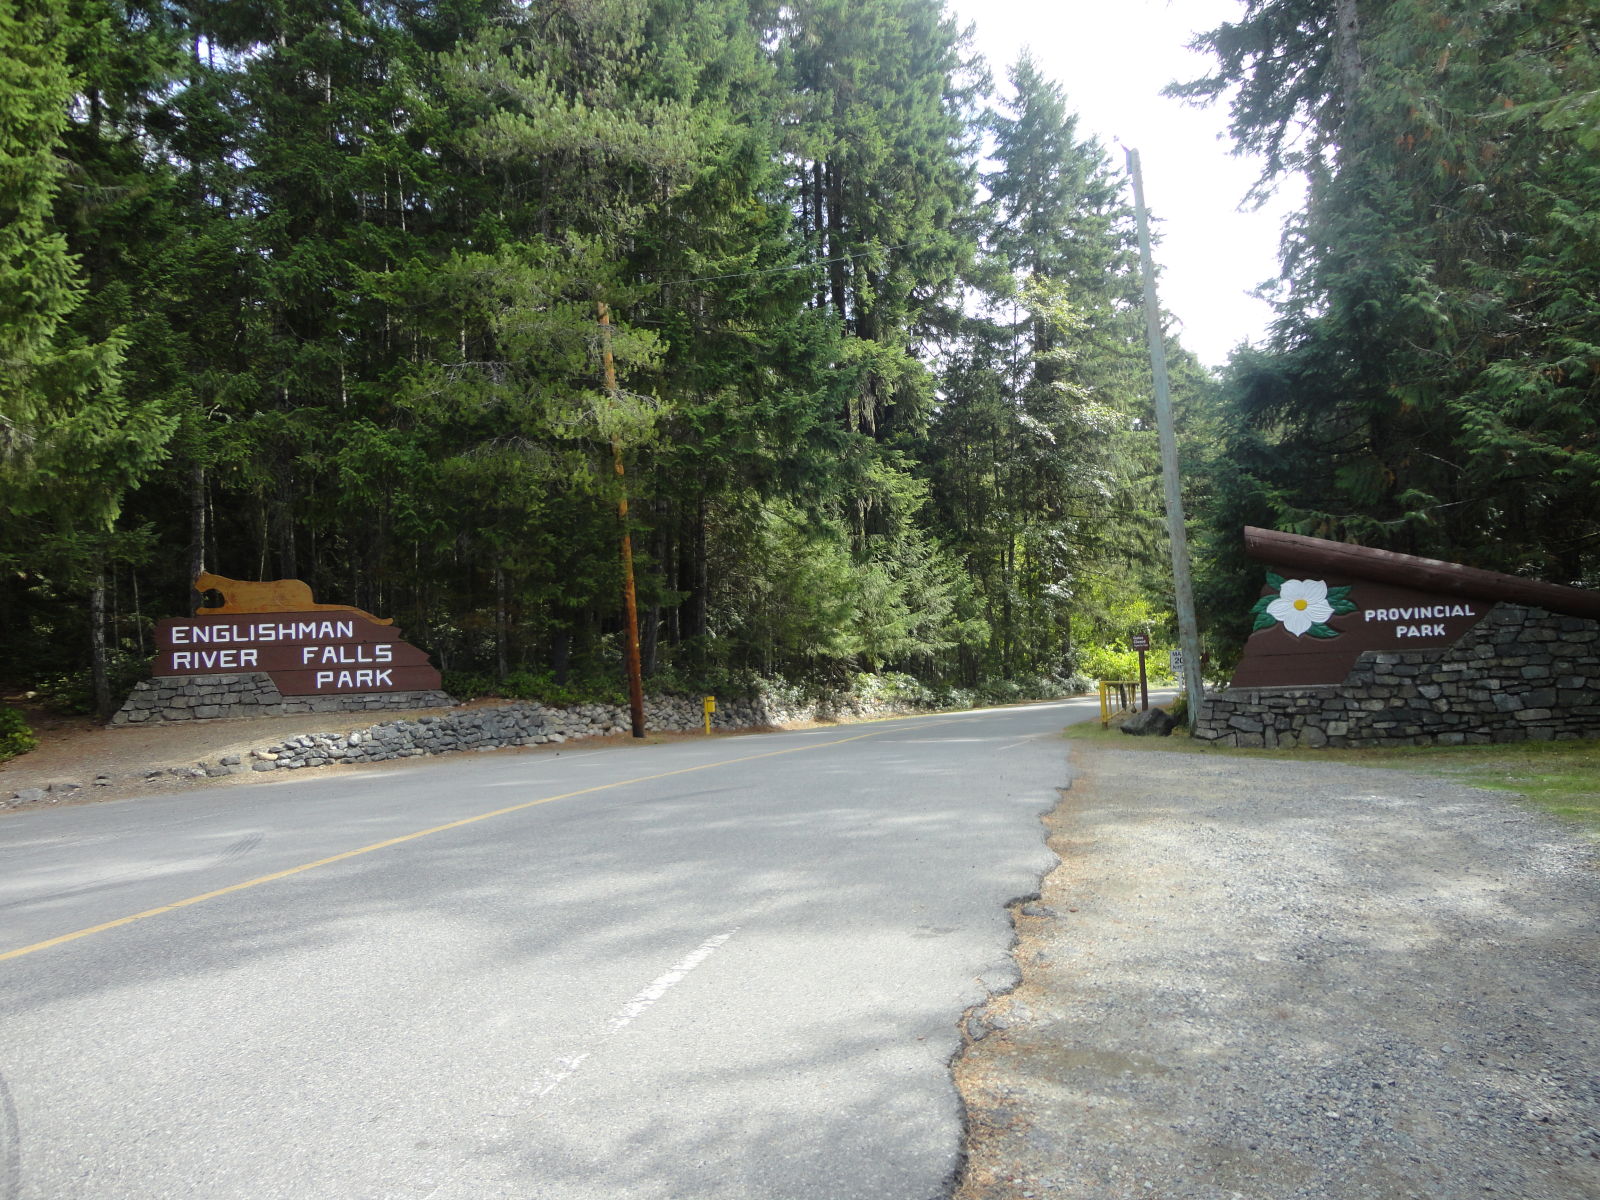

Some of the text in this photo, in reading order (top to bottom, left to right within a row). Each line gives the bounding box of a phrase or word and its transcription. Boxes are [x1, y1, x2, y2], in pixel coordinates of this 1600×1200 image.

[1364, 603, 1476, 622] PROVINCIAL
[172, 620, 354, 644] ENGLISHMAN
[1396, 623, 1446, 638] PARK
[172, 644, 393, 670] RIVER FALLS
[316, 669, 393, 689] PARK
